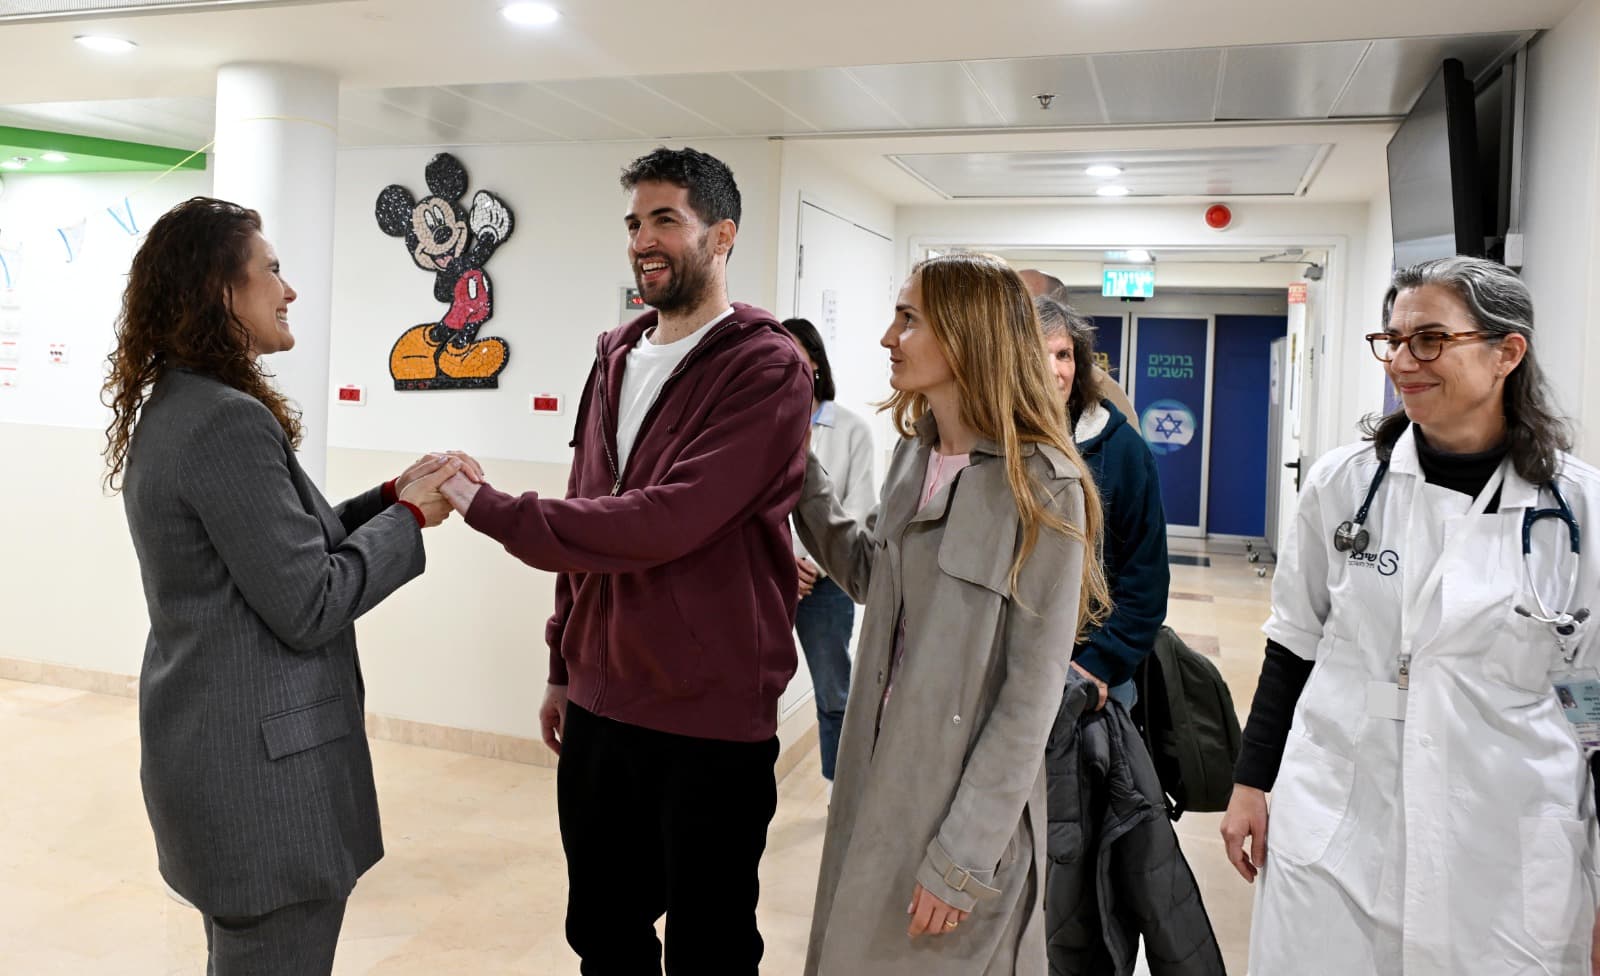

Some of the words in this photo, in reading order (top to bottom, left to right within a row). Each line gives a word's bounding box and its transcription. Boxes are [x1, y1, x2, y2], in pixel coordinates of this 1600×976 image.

[1106, 271, 1153, 296] יציאה
[1148, 353, 1194, 366] ברוכים
[1147, 366, 1194, 379] השבים
[1349, 550, 1378, 562] שיבא
